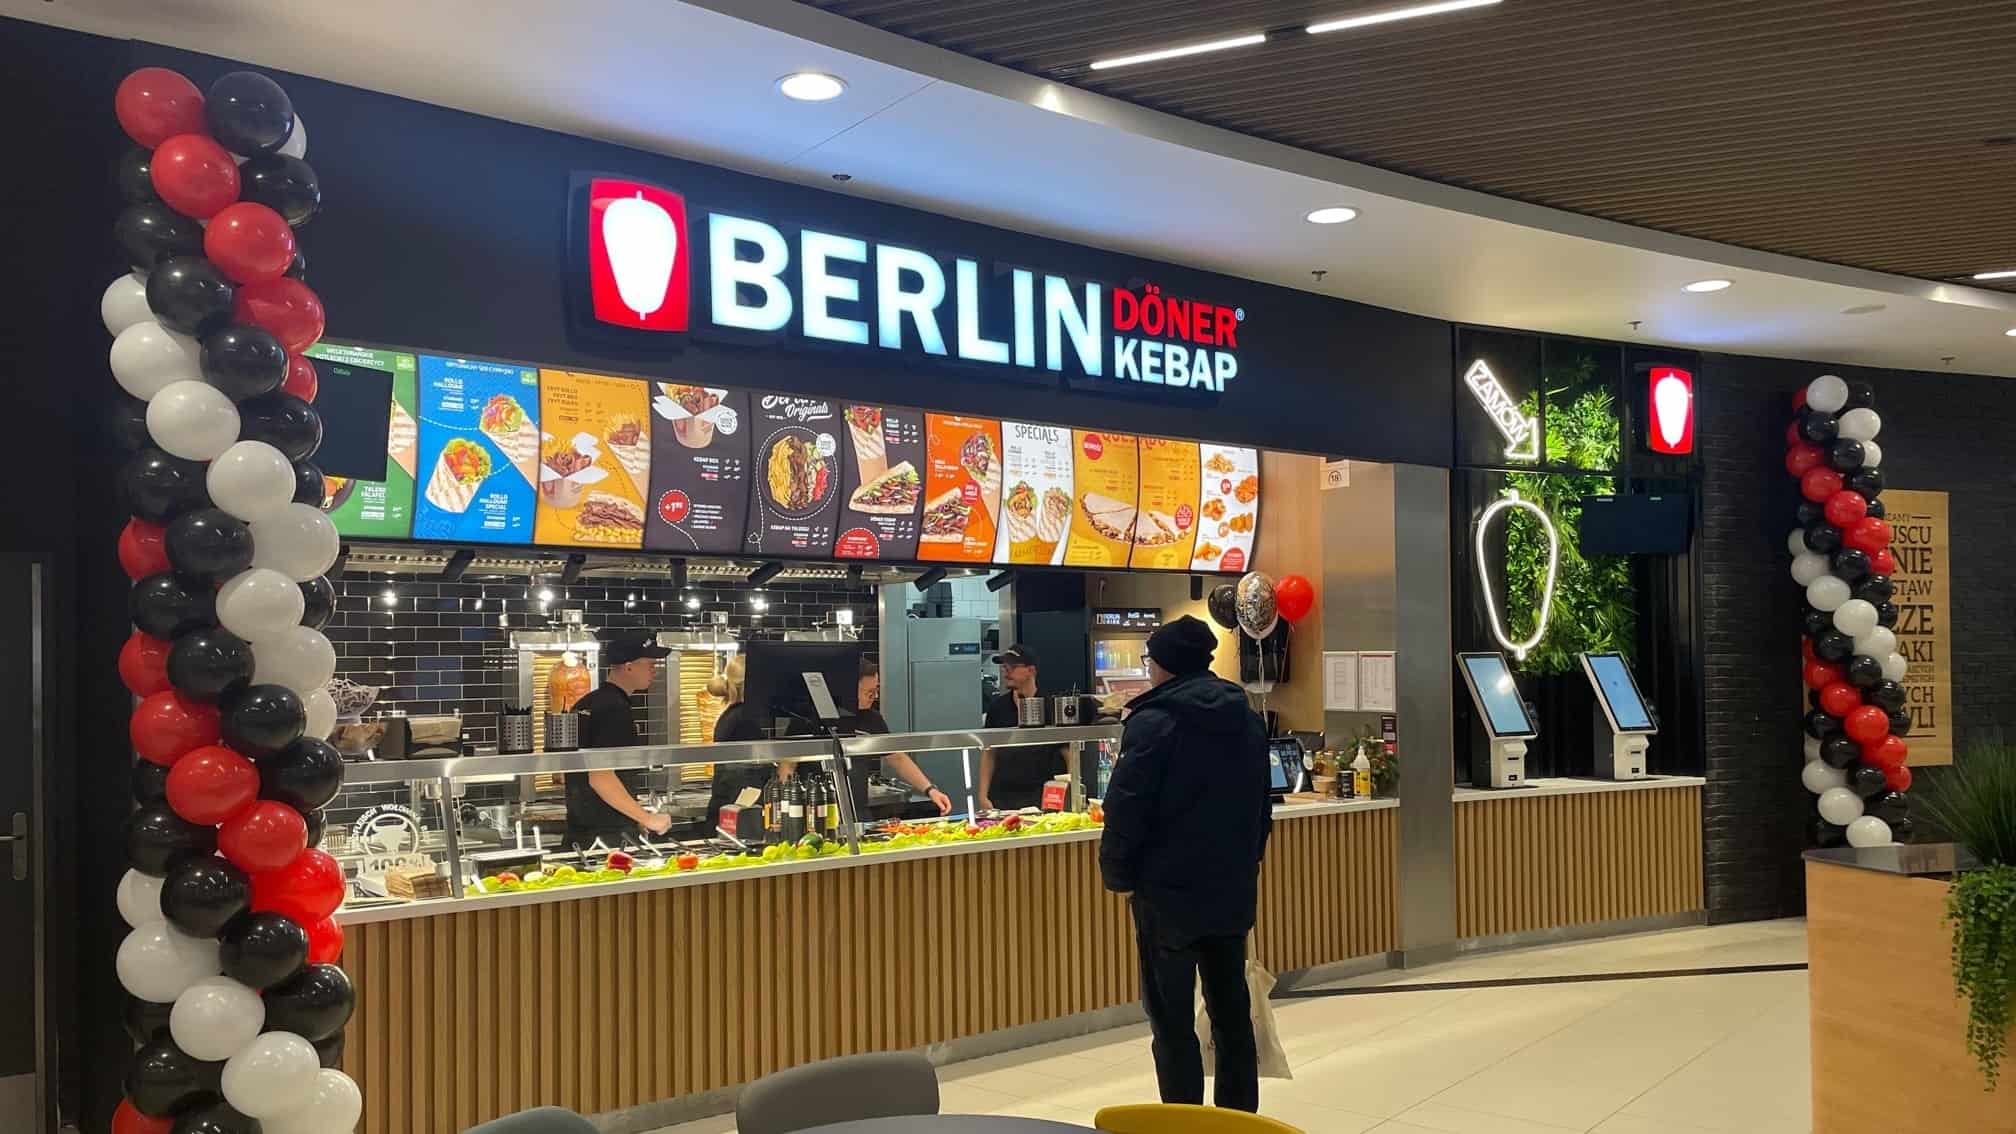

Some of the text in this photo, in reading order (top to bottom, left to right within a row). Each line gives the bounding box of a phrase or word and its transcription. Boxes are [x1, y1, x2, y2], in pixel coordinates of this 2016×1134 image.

[708, 213, 1101, 377] BERLIN
[1114, 336, 1237, 392] KEBAP
[785, 401, 829, 422] Originals
[1015, 425, 1060, 445] SPECIALS
